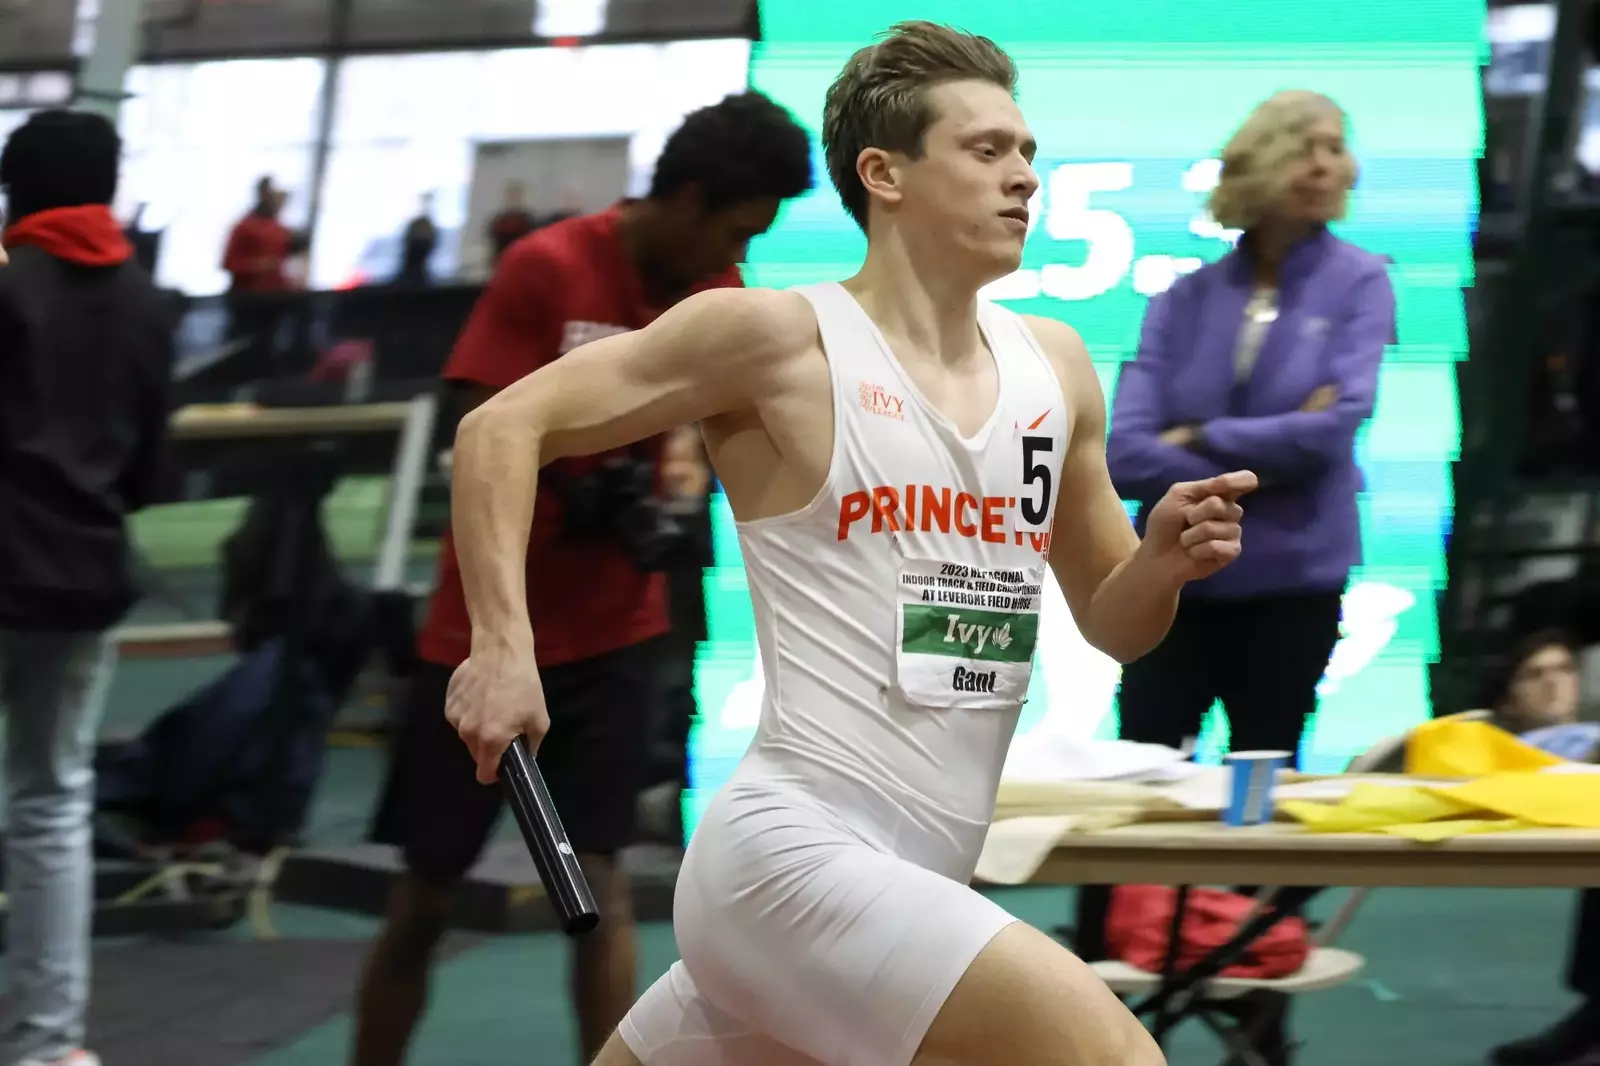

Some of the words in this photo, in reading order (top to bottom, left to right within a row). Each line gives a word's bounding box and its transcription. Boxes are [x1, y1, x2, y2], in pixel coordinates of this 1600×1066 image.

[873, 391, 904, 412] IVY
[1020, 435, 1053, 526] 5
[837, 484, 1051, 553] PRINCE
[940, 563, 969, 578] 2023
[902, 574, 935, 586] INDOOR
[936, 577, 965, 589] TRACK
[967, 581, 973, 590] &
[975, 581, 996, 592] FIELD
[922, 589, 934, 601] AT
[937, 590, 986, 606] LEVERONE
[988, 594, 1011, 609] FIELD
[943, 613, 992, 654] Ivy
[952, 666, 996, 693] Gant
